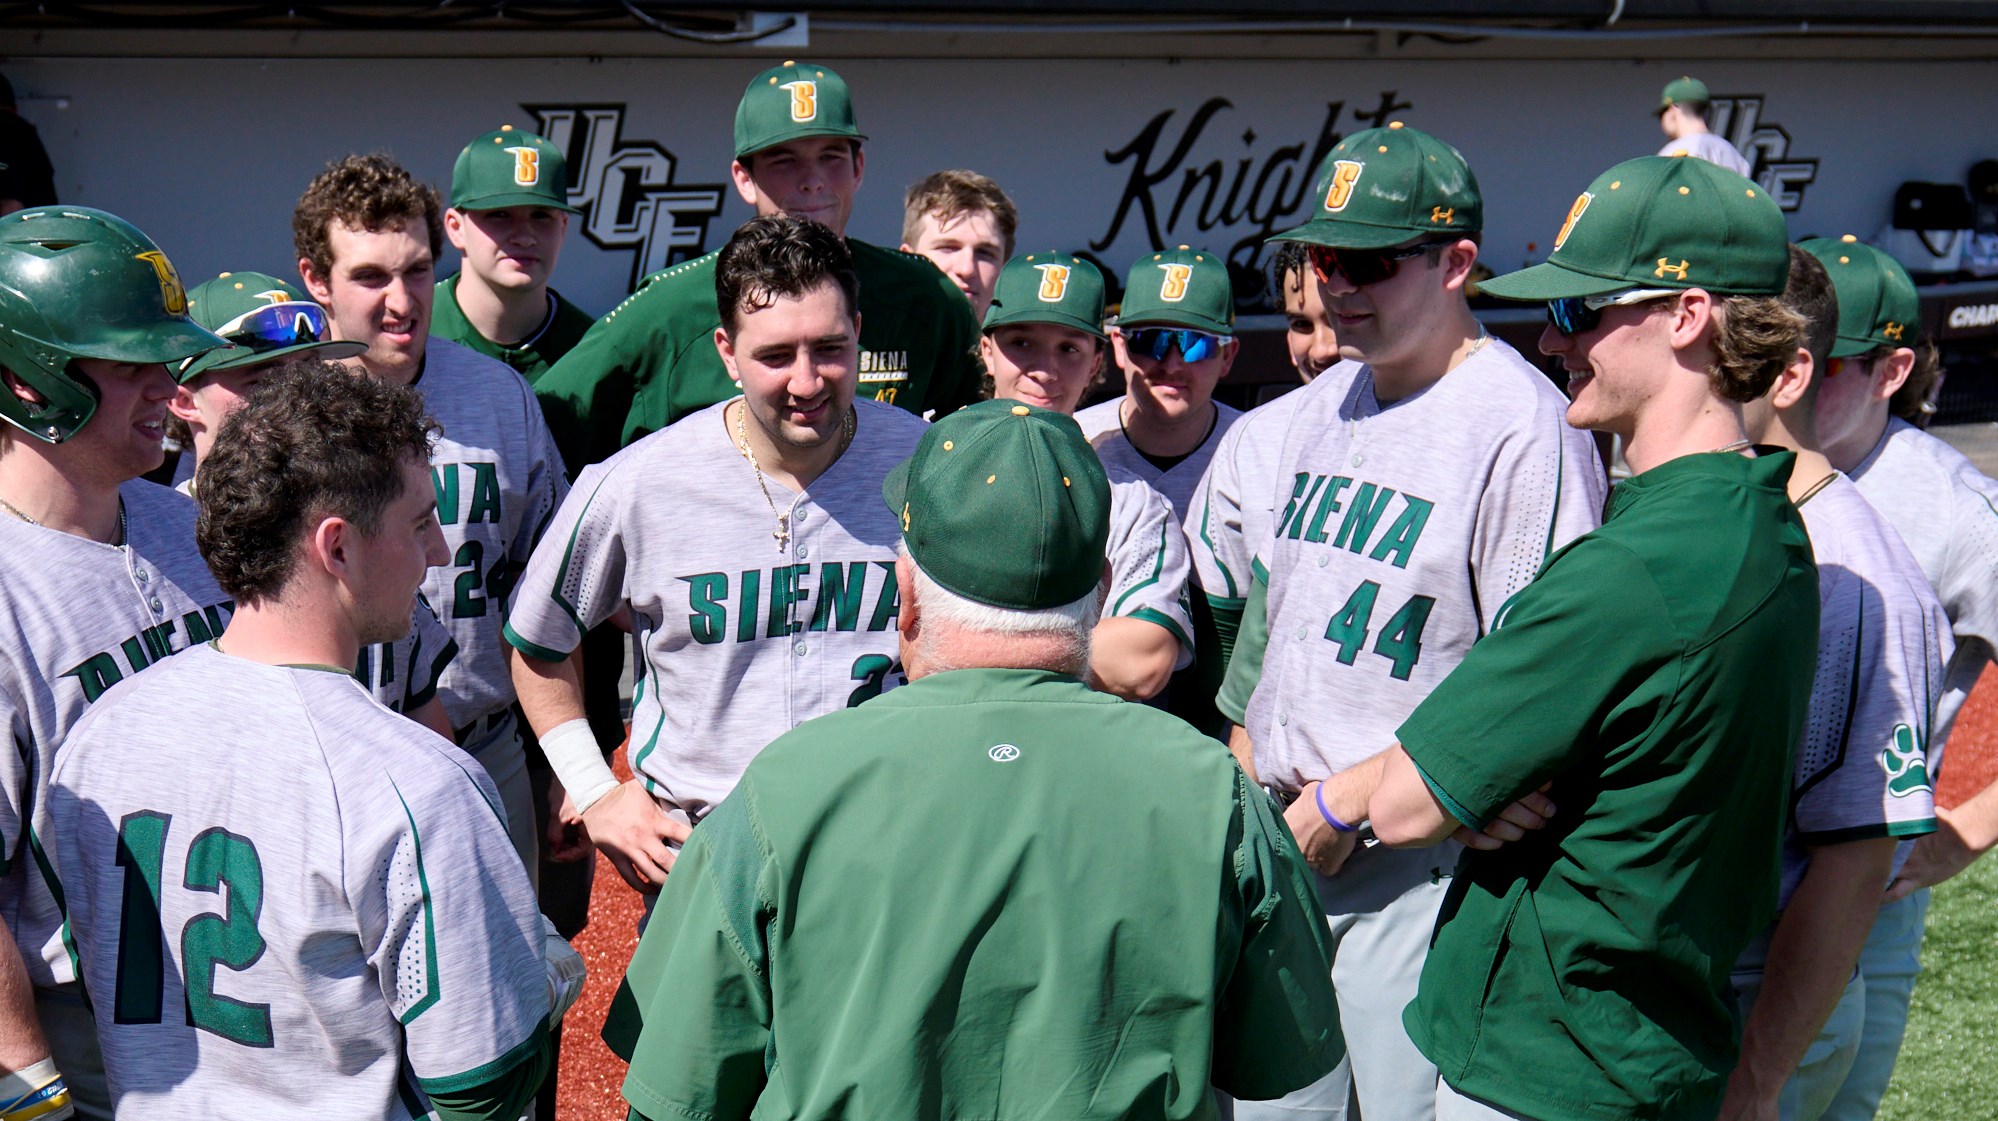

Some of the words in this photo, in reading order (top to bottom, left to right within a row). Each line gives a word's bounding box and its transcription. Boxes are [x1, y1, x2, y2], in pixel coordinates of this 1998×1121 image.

[779, 80, 818, 122] S
[503, 147, 540, 187] S
[1326, 159, 1366, 213] S
[519, 103, 727, 294] UCF
[1033, 263, 1072, 303] S
[1157, 263, 1194, 303] S
[860, 350, 908, 372] SIENA
[1276, 471, 1435, 570] SIENA
[1324, 578, 1437, 682] 44
[114, 808, 275, 1049] 12
